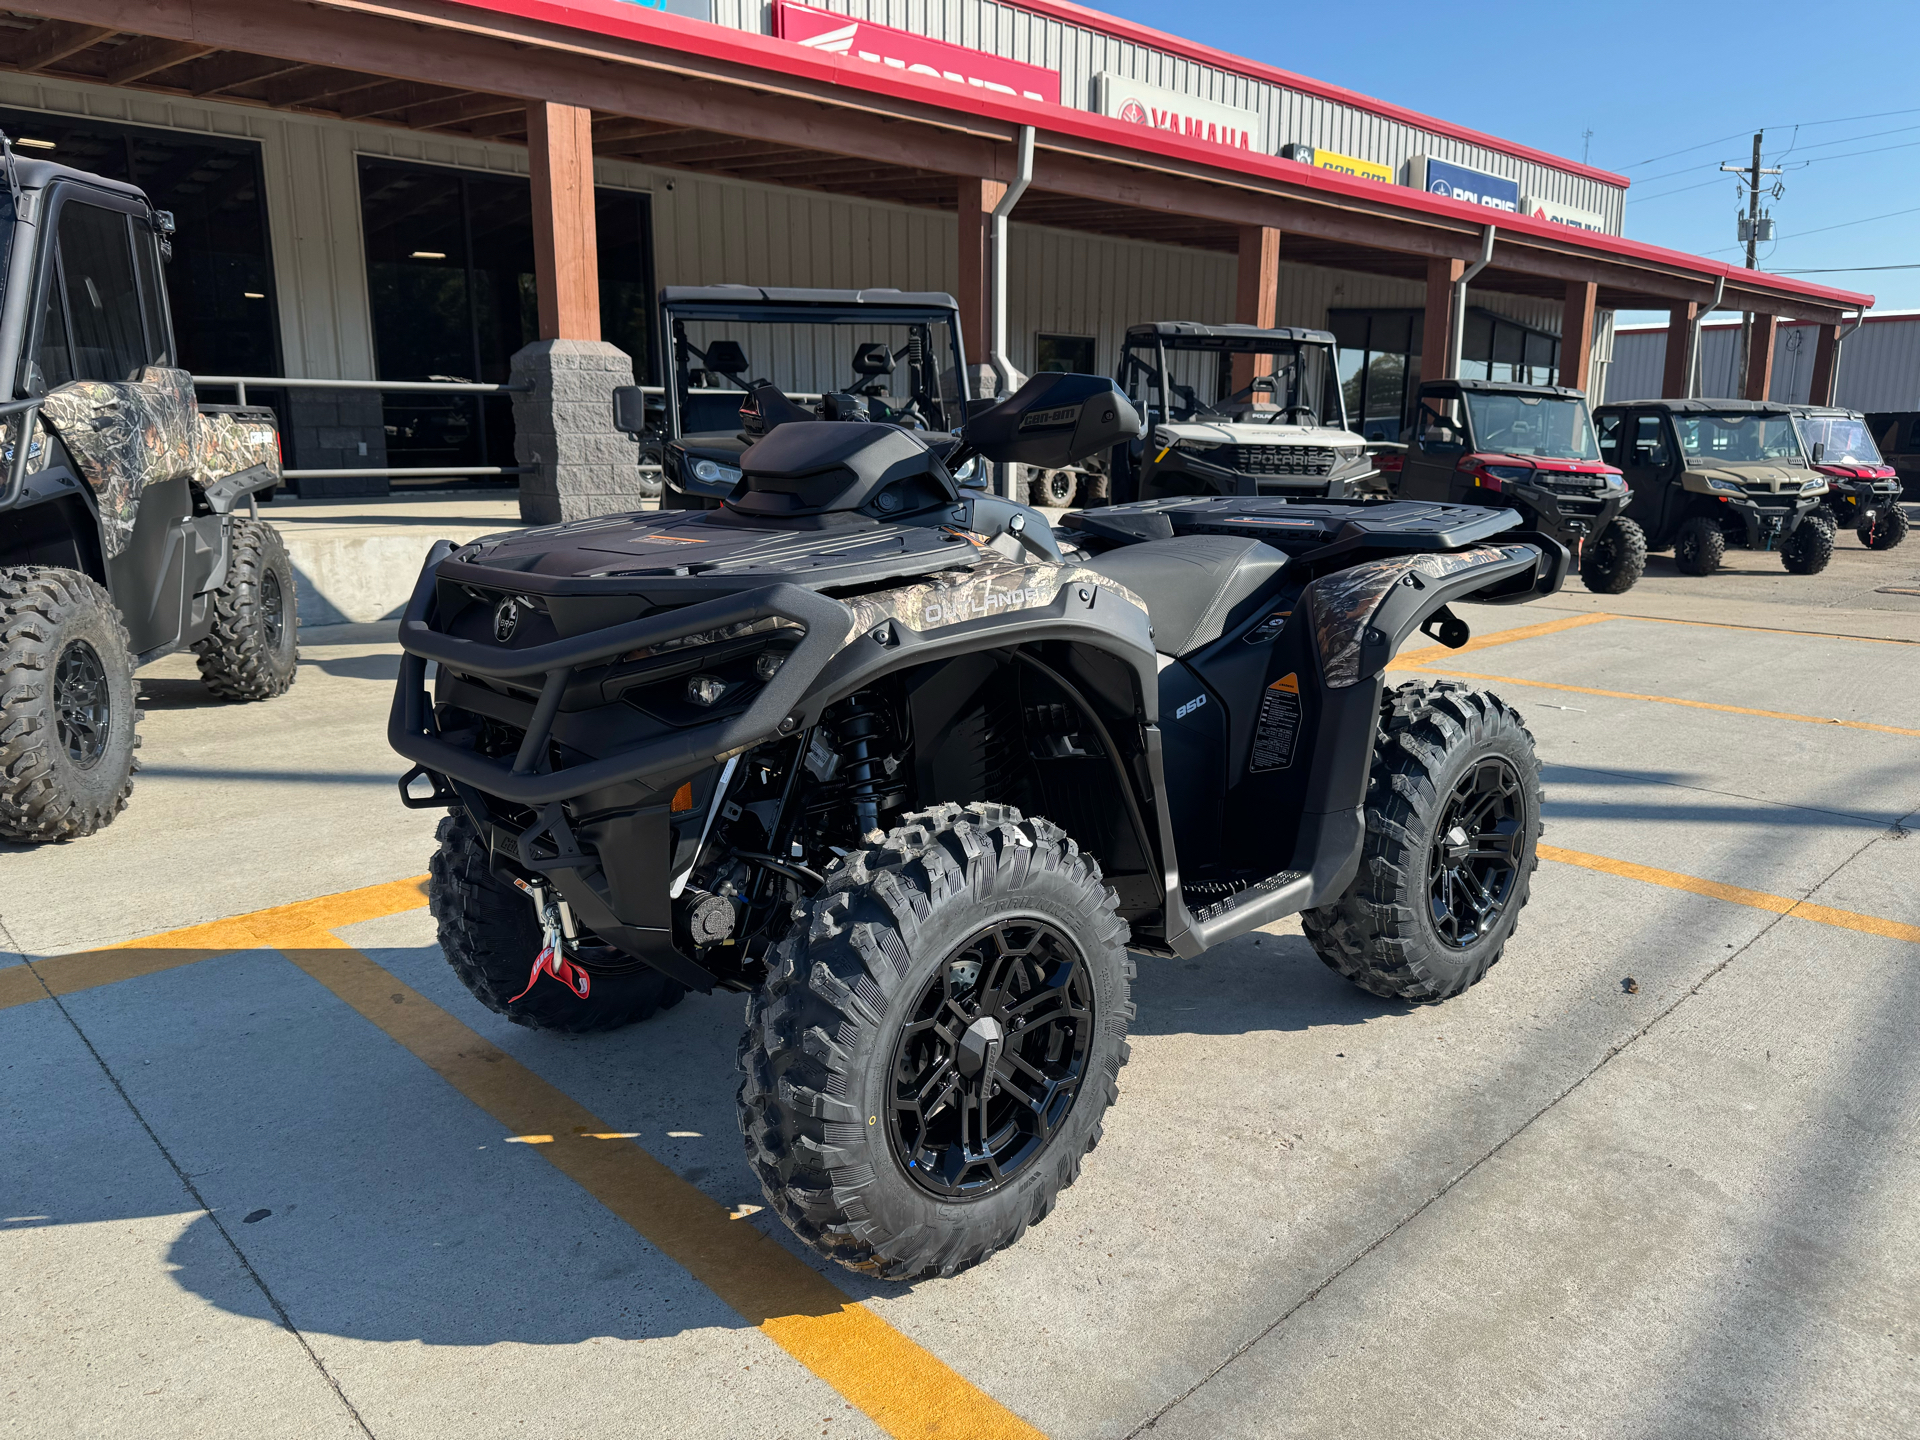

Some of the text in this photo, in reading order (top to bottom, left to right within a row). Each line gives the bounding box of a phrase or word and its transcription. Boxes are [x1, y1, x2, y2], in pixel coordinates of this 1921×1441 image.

[1250, 454, 1318, 466] POLARIS
[500, 619, 515, 629] BRP
[1176, 694, 1207, 719] 850
